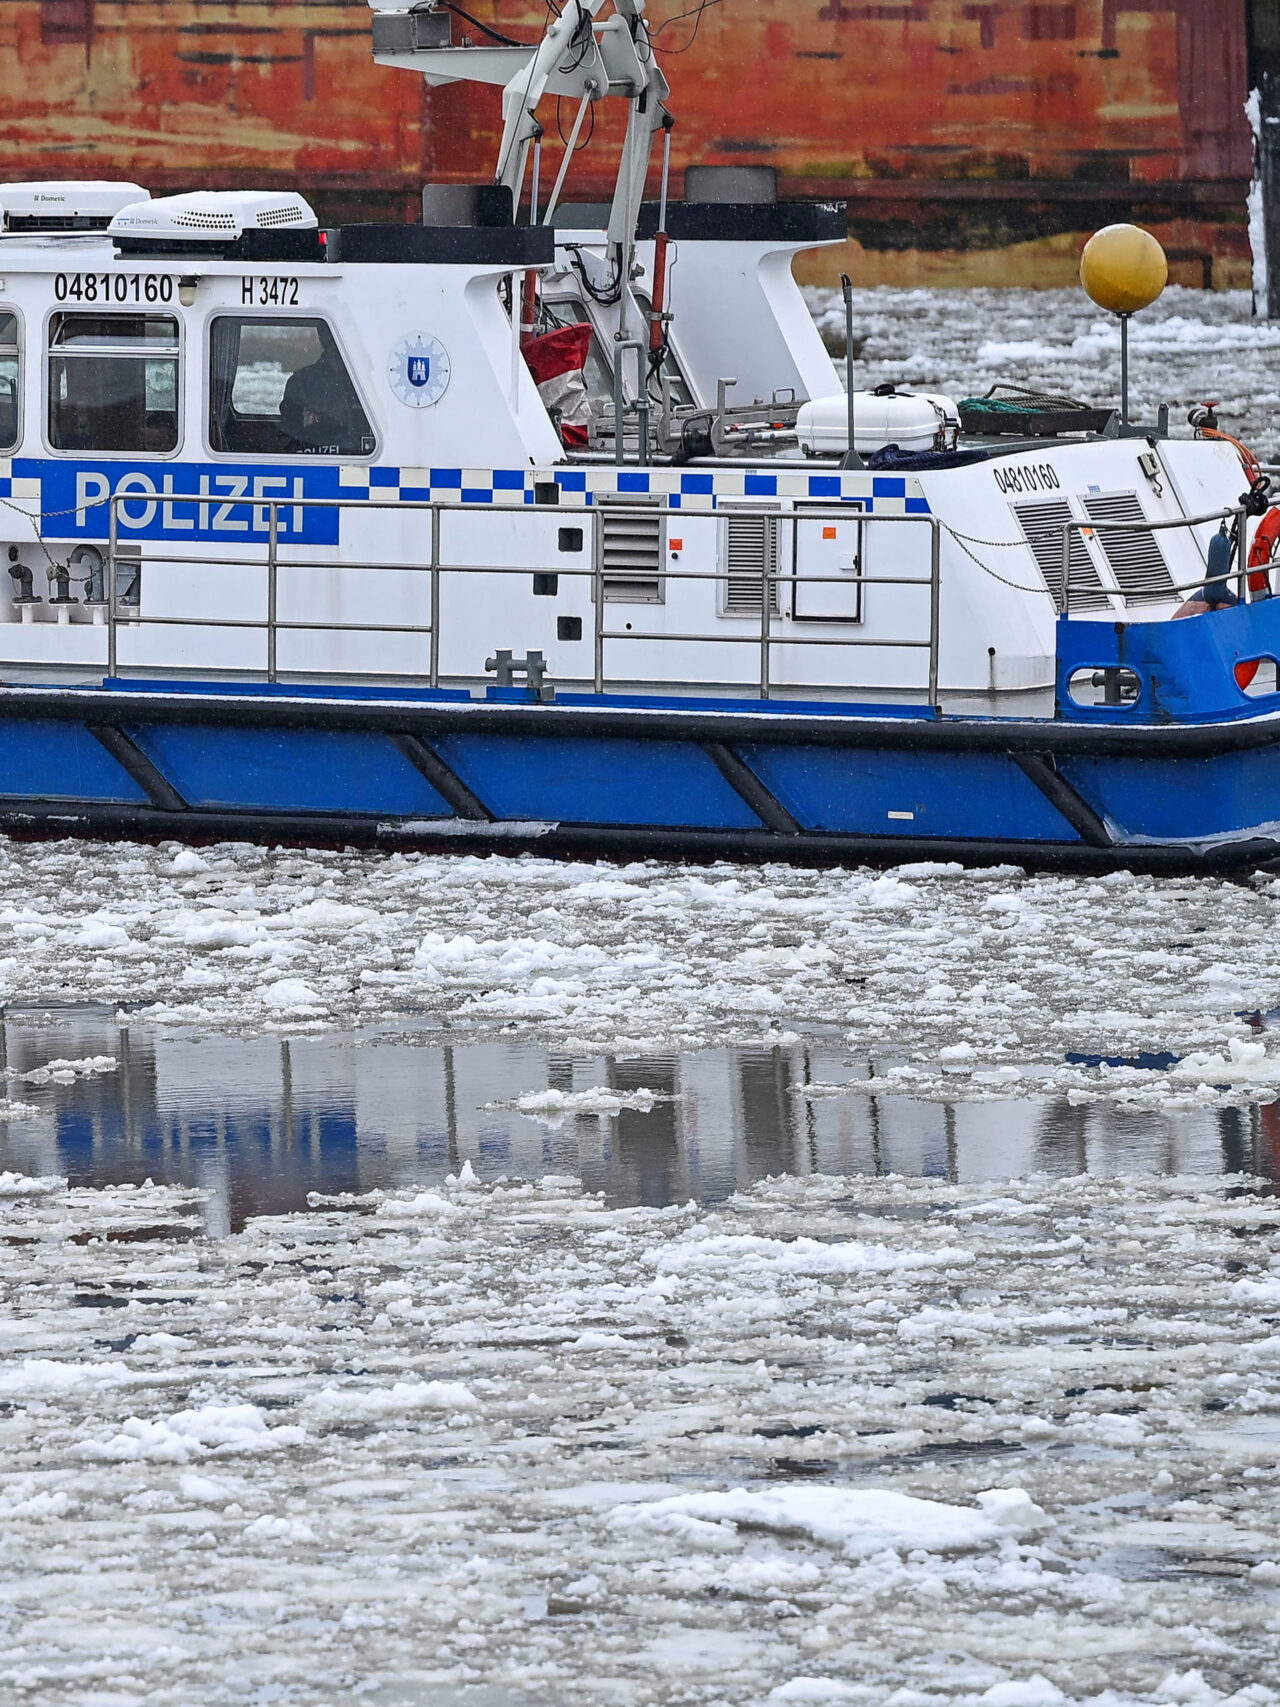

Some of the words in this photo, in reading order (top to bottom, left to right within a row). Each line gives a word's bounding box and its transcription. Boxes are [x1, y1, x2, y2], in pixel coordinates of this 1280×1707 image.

[55, 273, 173, 302] 04810160
[242, 276, 254, 304] H
[259, 277, 299, 306] 3472
[993, 463, 1060, 494] 04810160
[76, 471, 304, 532] POLIZEI
